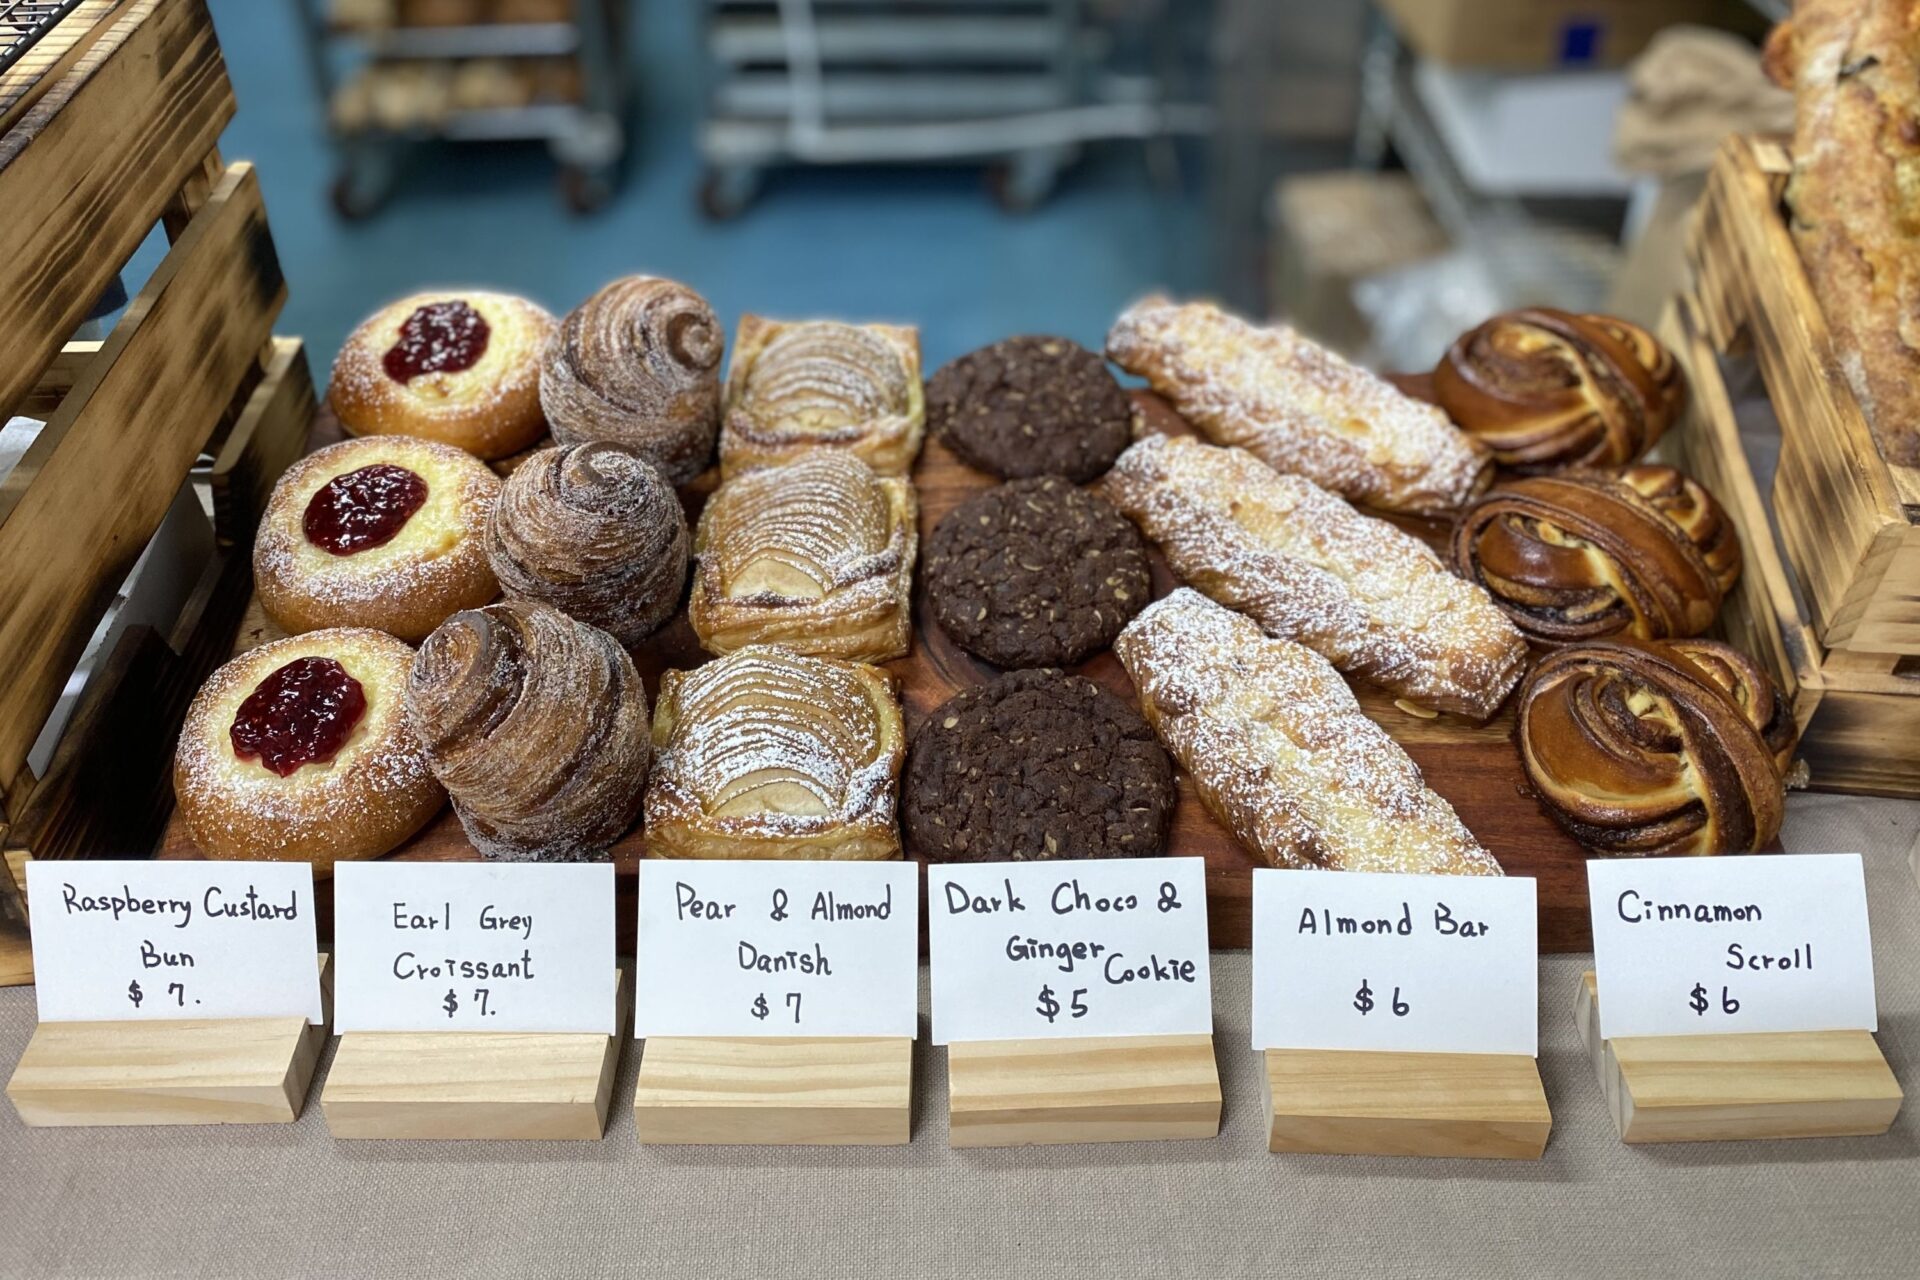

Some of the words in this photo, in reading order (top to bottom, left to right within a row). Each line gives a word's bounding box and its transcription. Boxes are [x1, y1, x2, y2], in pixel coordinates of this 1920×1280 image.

[62, 882, 192, 929] Raspberry
[203, 884, 298, 921] Custard
[675, 881, 737, 921] Pear
[770, 888, 789, 922] &
[811, 883, 891, 922] Almond
[944, 878, 1026, 915] Dark
[1051, 879, 1138, 915] Choco
[1157, 881, 1182, 913] &
[1617, 889, 1762, 924] Cinnamon
[393, 902, 450, 930] Earl
[479, 904, 532, 940] Grey
[1298, 902, 1413, 936] Almond
[1434, 902, 1489, 938] Bar
[140, 939, 195, 969] Bun
[393, 949, 535, 980] Croissant
[738, 940, 832, 976] Danish
[1005, 935, 1105, 973] Ginger
[1104, 952, 1196, 985] Cookie
[1726, 943, 1812, 971] Scroll
